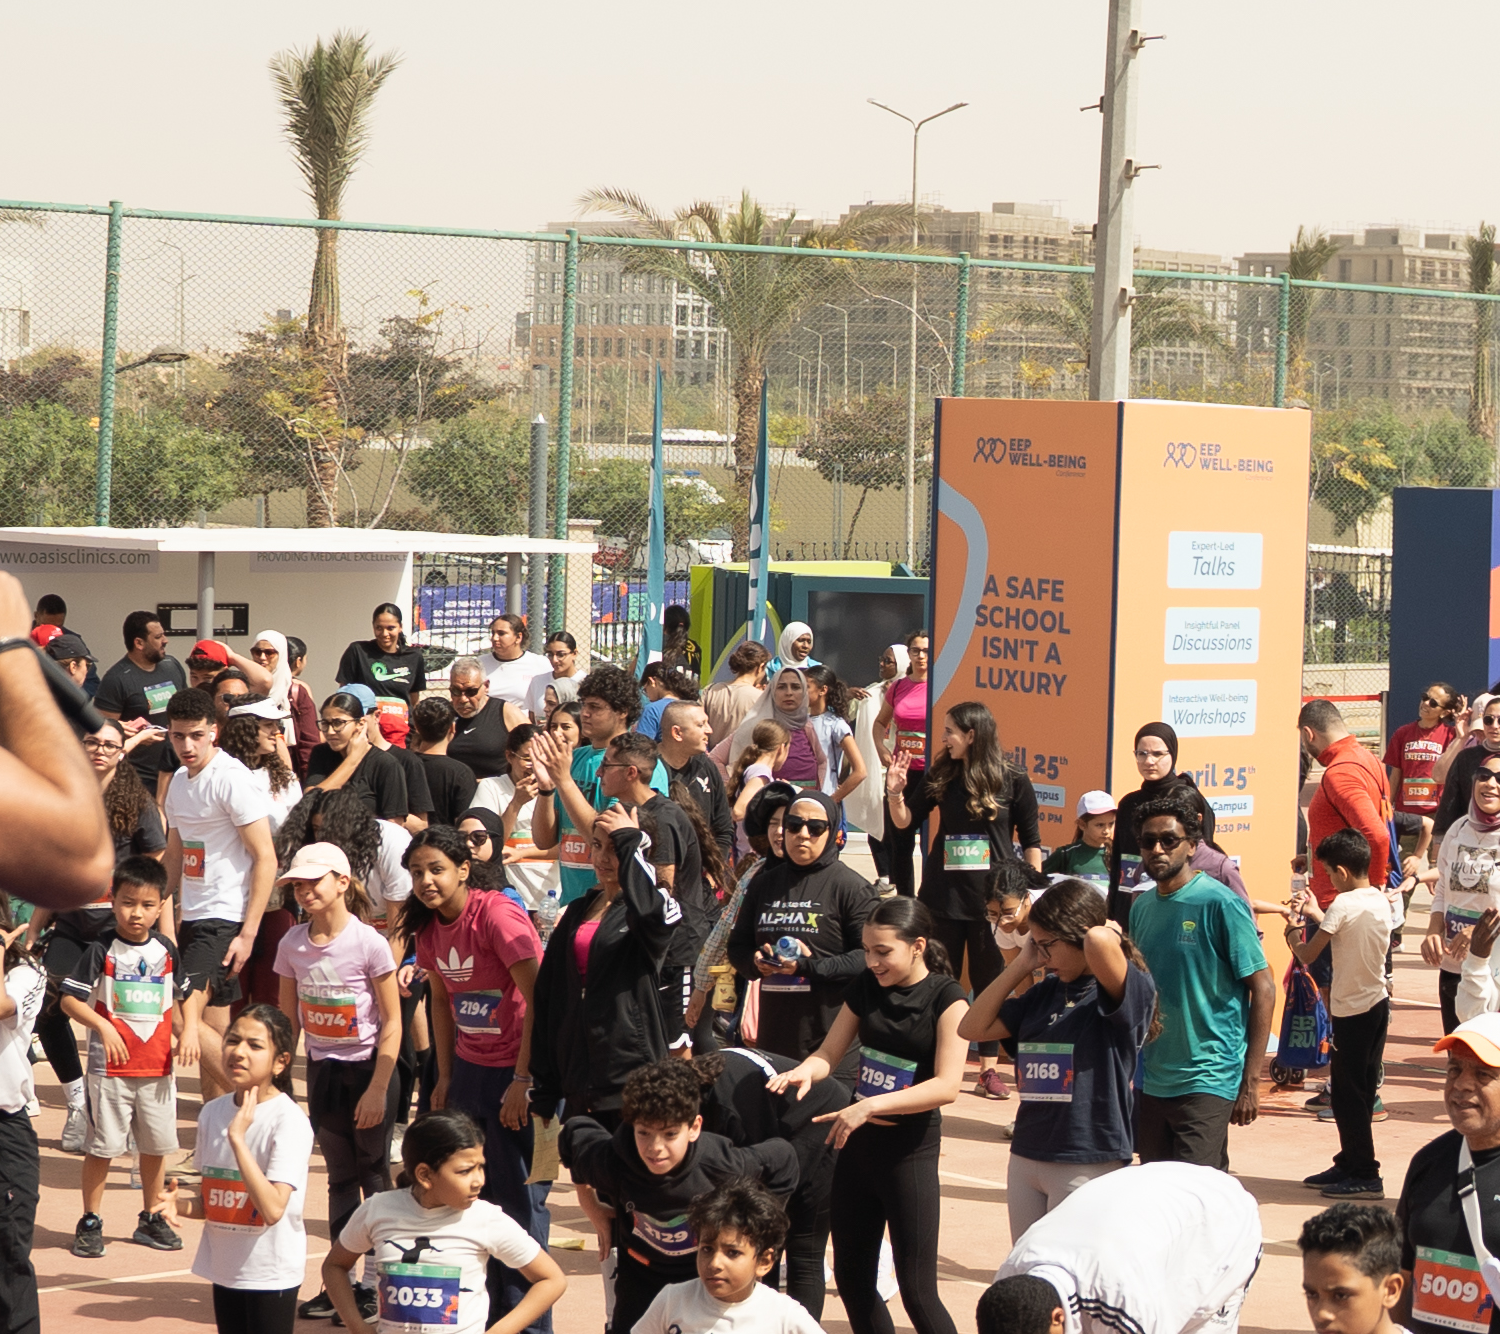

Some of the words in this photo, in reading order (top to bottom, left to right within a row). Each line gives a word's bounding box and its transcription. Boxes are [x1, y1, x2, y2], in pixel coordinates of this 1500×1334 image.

[1009, 438, 1031, 451] EEP
[1200, 443, 1221, 456] EEP
[1009, 452, 1086, 470] WELL-BEING
[1200, 456, 1274, 473] WELL-BEING
[1191, 540, 1235, 552] Expert-Led
[257, 552, 307, 563] PROVIDING
[310, 552, 347, 563] MEDICAL
[1192, 556, 1235, 576] Talks
[984, 575, 1000, 598] A
[1006, 576, 1065, 603] SAFE
[976, 605, 1071, 636] SCHOOL
[1185, 620, 1219, 632] Insightful
[1221, 620, 1241, 631] Panel
[982, 637, 1038, 664] ISN'T
[1044, 643, 1062, 665] A
[1172, 634, 1253, 651] Discussions
[976, 667, 1067, 697] LUXURY
[1169, 694, 1208, 704] Interactive
[1209, 693, 1249, 706] Well-being
[1172, 708, 1246, 727] Workshops
[1404, 738, 1443, 755] STANFORD
[1032, 754, 1068, 780] 25th
[1223, 766, 1256, 790] 25th
[1212, 801, 1248, 814] Campus
[1237, 823, 1251, 833] PM
[952, 845, 980, 857] 1014
[124, 988, 161, 1004] 1004
[459, 999, 490, 1017] 2194
[307, 1009, 347, 1027] 5074
[862, 1065, 897, 1091] 2195
[1025, 1063, 1060, 1080] 2168
[208, 1188, 249, 1209] 5187
[1421, 1272, 1479, 1303] 5009
[386, 1287, 444, 1309] 2033
